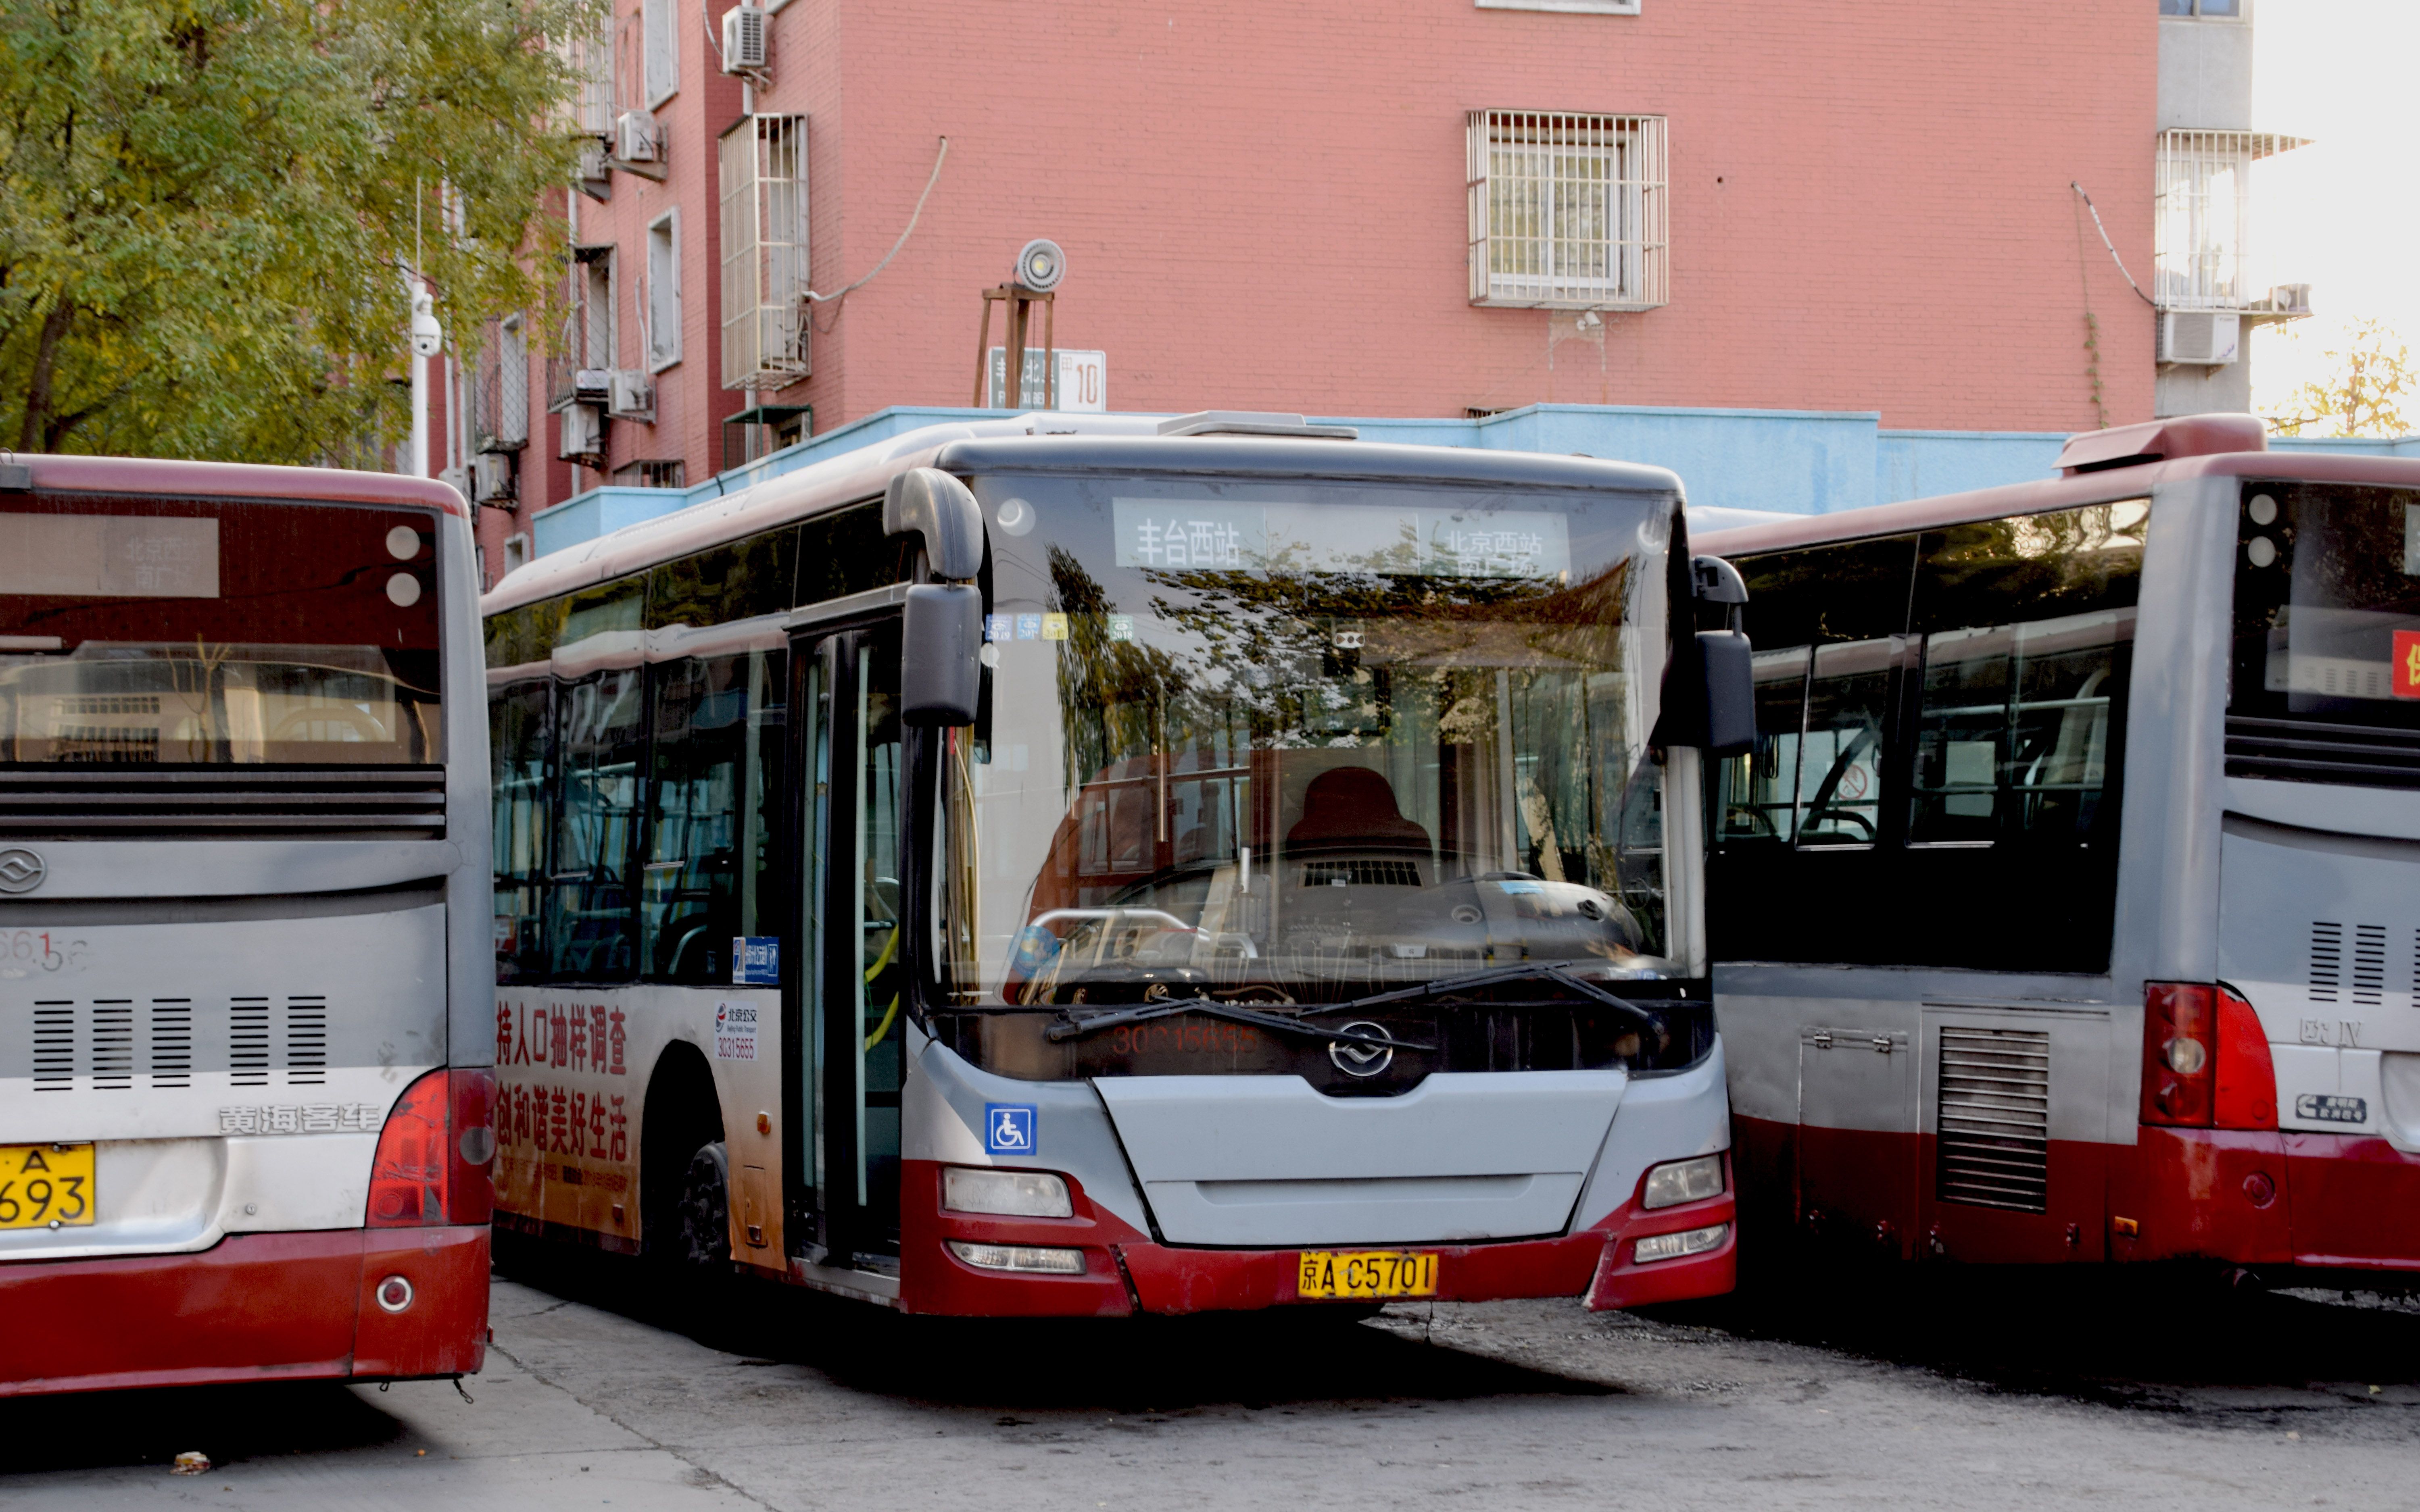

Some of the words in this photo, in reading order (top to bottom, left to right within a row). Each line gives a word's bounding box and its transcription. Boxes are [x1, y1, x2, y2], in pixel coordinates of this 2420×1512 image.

[1077, 364, 1097, 404] 10
[125, 536, 202, 562] 北京西
[1137, 518, 1240, 566] 丰台西站
[1445, 530, 1543, 555] 北京西站
[1020, 629, 1036, 639] 201
[1112, 630, 1133, 639] 2018
[728, 1008, 757, 1023] 北京公交
[496, 1000, 626, 1075] 持人口抽样调查
[718, 1037, 754, 1060] 30315655
[219, 1102, 380, 1134] 黄海客车
[497, 1080, 627, 1162] 创和谐美好生活
[0, 1176, 85, 1223] 693
